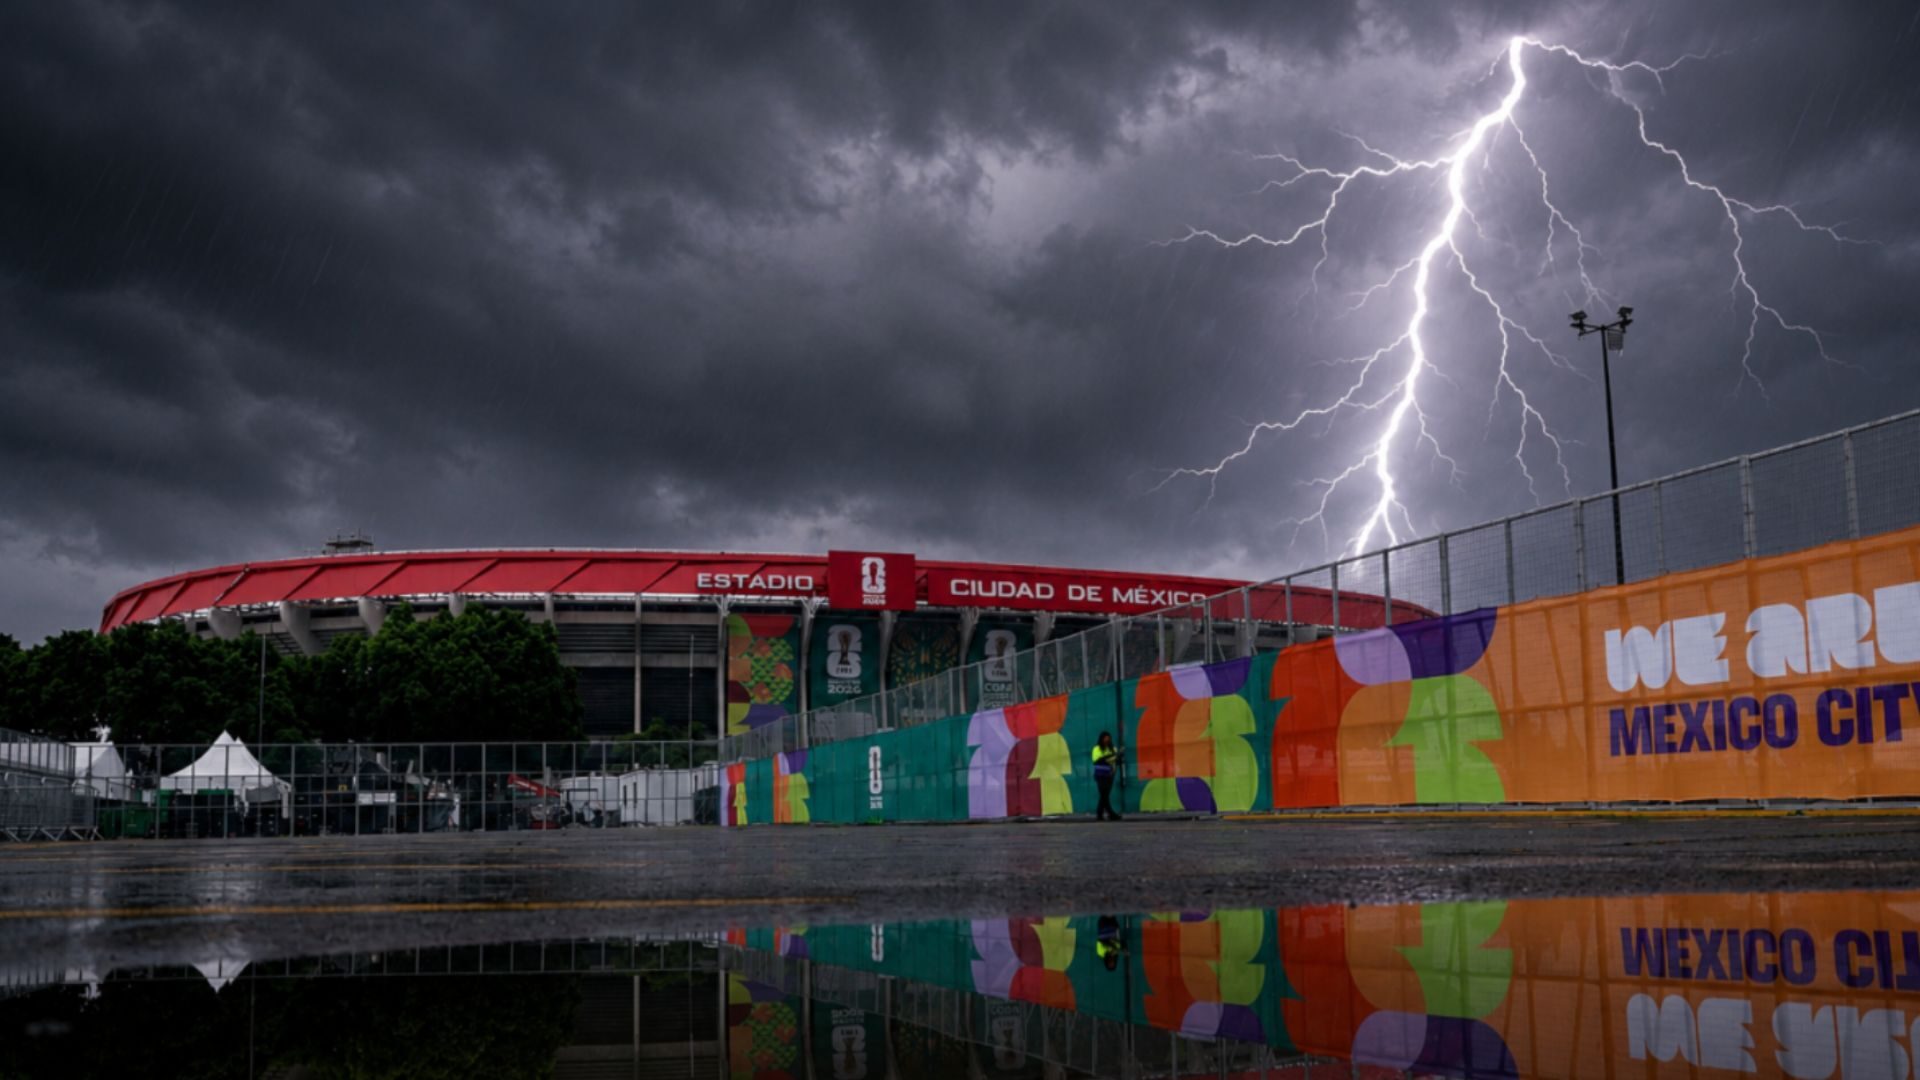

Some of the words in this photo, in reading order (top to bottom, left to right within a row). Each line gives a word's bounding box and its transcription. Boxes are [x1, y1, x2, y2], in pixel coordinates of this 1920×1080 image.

[697, 572, 814, 590] ESTADIO
[950, 578, 1054, 600] CIUDAD
[1067, 585, 1103, 602] DE
[1112, 584, 1207, 607] MÉXICO
[1604, 612, 1730, 693] WE
[1609, 693, 1799, 757] MEXICO
